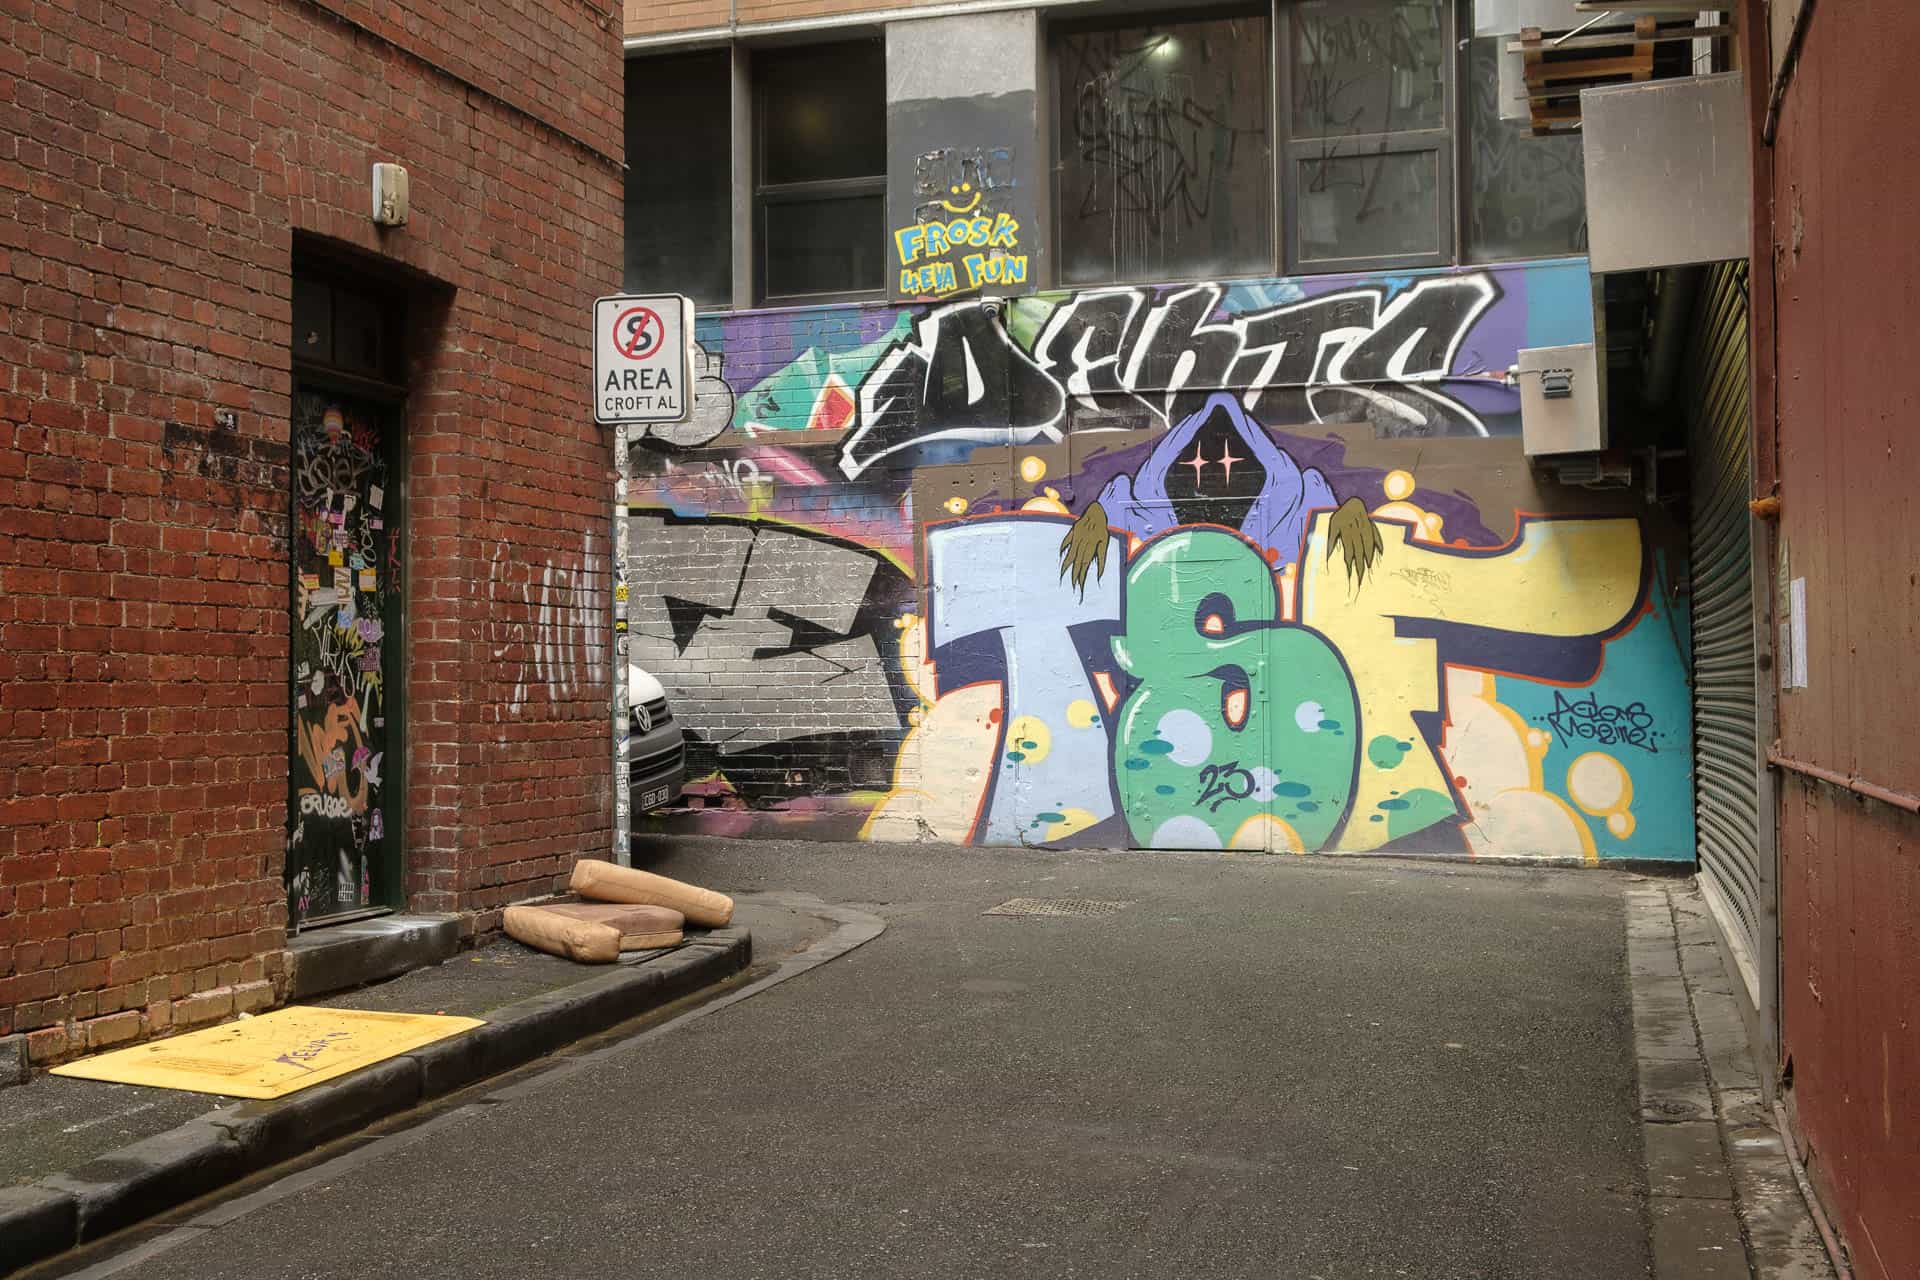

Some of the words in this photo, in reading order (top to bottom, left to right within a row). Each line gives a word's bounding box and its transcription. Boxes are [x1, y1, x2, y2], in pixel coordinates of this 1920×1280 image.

[895, 213, 1019, 265] FROSK
[961, 252, 1029, 289] FUN
[604, 367, 673, 392] AREA
[604, 395, 654, 411] CROFT
[657, 395, 678, 410] AL
[1193, 760, 1256, 807] 23
